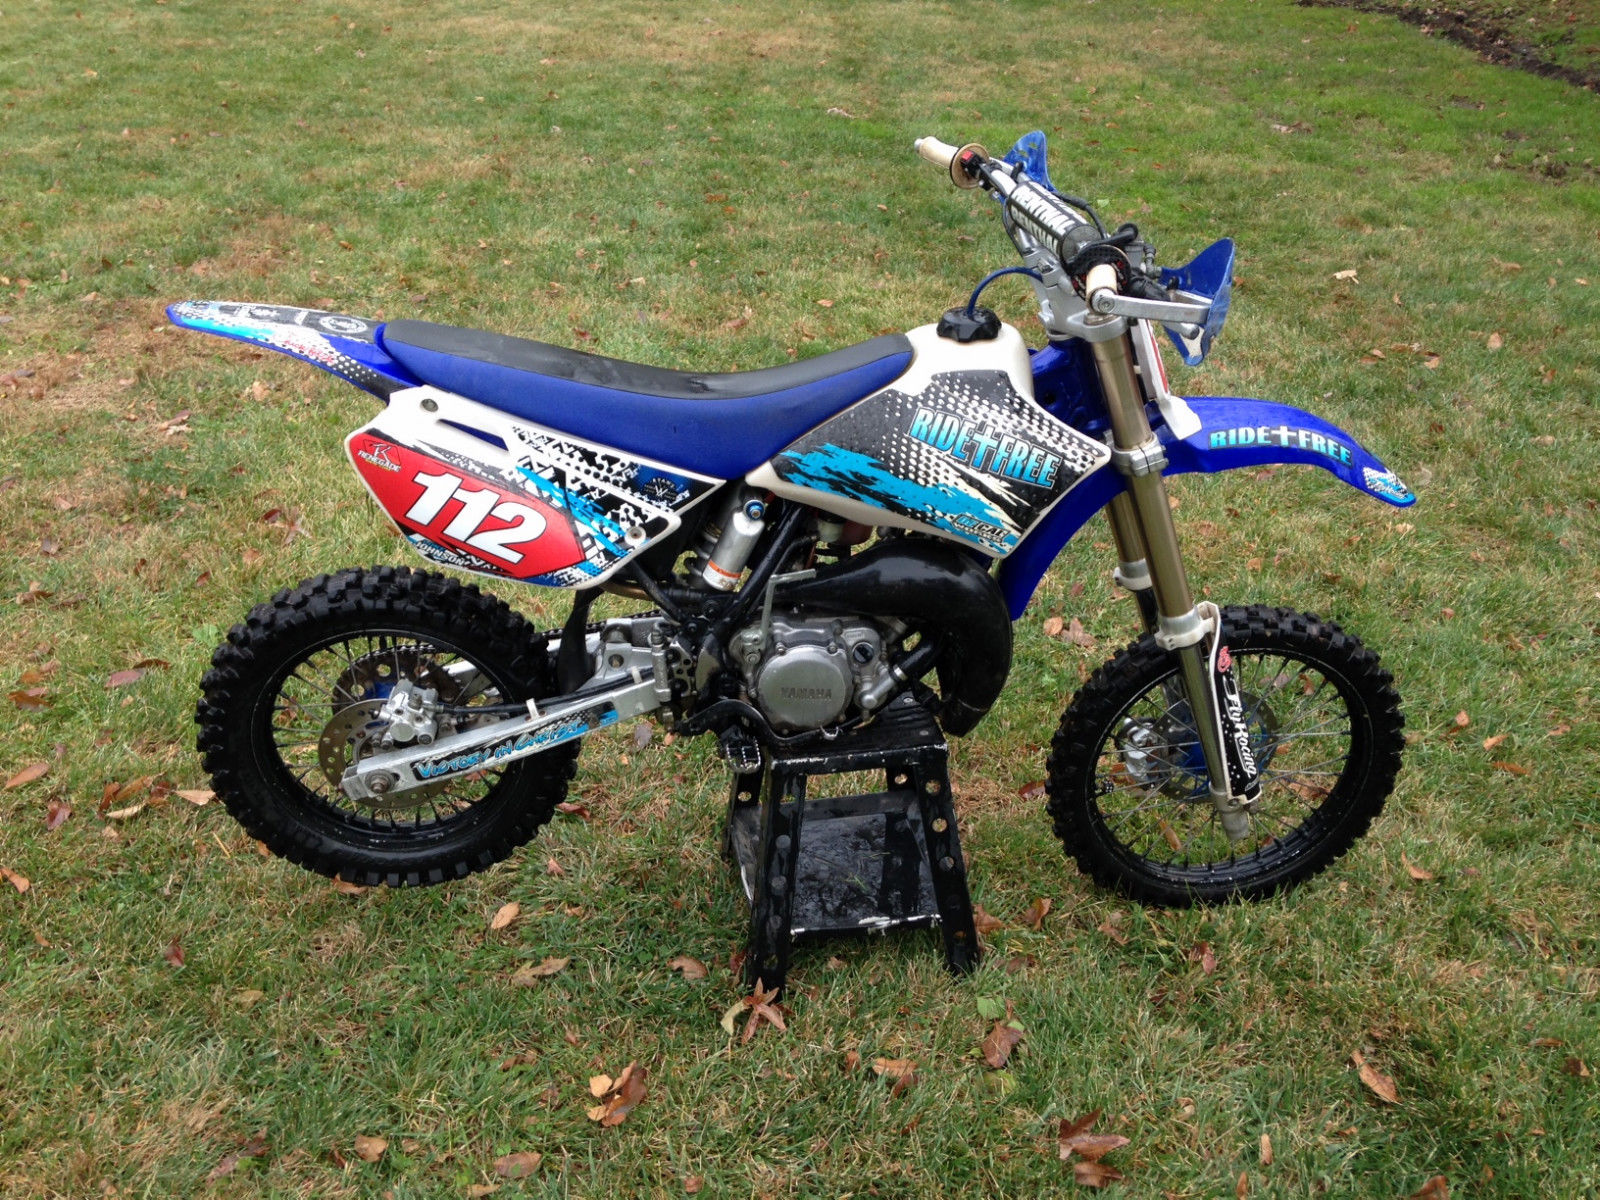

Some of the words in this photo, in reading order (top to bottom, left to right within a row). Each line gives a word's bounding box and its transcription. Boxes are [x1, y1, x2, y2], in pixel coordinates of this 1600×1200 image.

[1010, 185, 1076, 236] RENTHAL
[406, 471, 547, 565] 112
[416, 541, 465, 566] JOHNSON
[781, 687, 832, 699] YAMAHA
